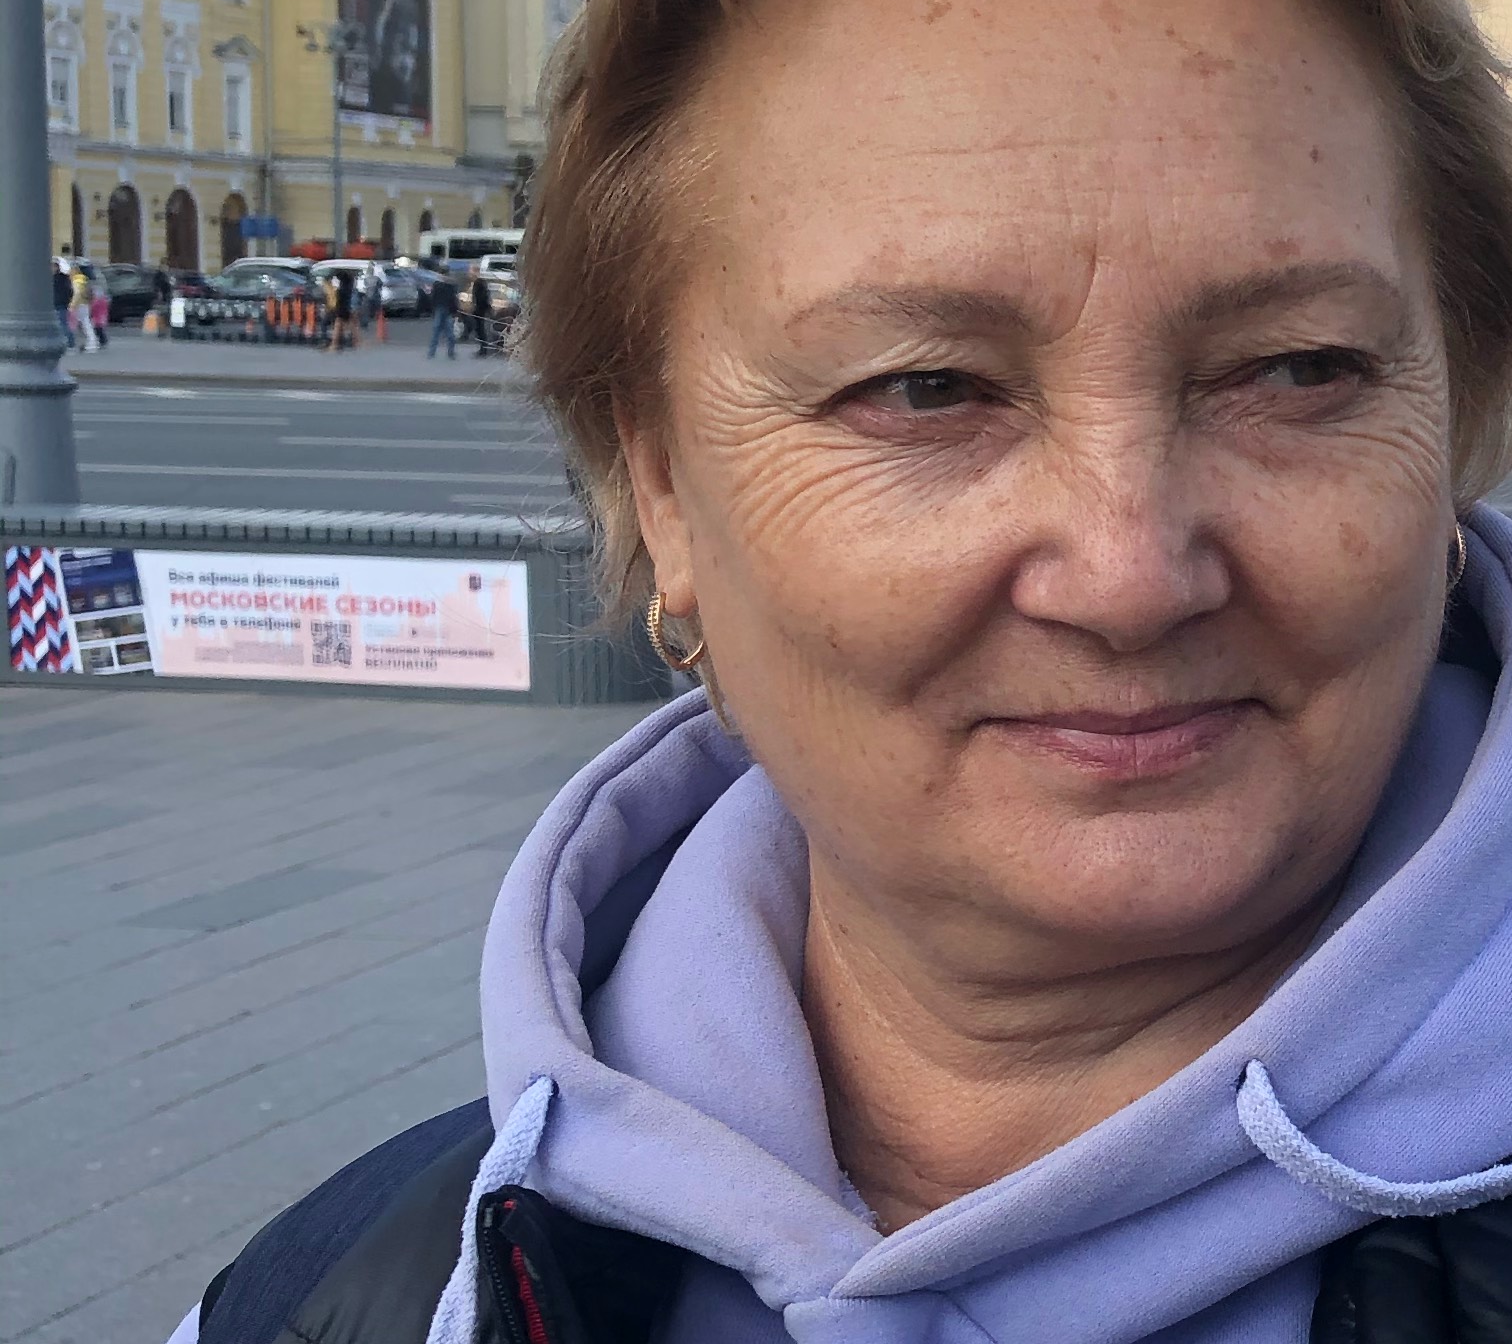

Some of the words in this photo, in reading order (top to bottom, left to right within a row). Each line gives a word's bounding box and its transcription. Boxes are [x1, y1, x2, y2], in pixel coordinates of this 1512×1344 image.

[169, 568, 194, 584] Вся
[199, 570, 249, 587] афиша
[253, 570, 340, 588] фестивалей
[170, 591, 328, 613] МОСКОВСКИЕ
[335, 595, 437, 617] СЕЗОНЫ
[184, 613, 215, 626] тебя
[233, 616, 302, 631] телефоне
